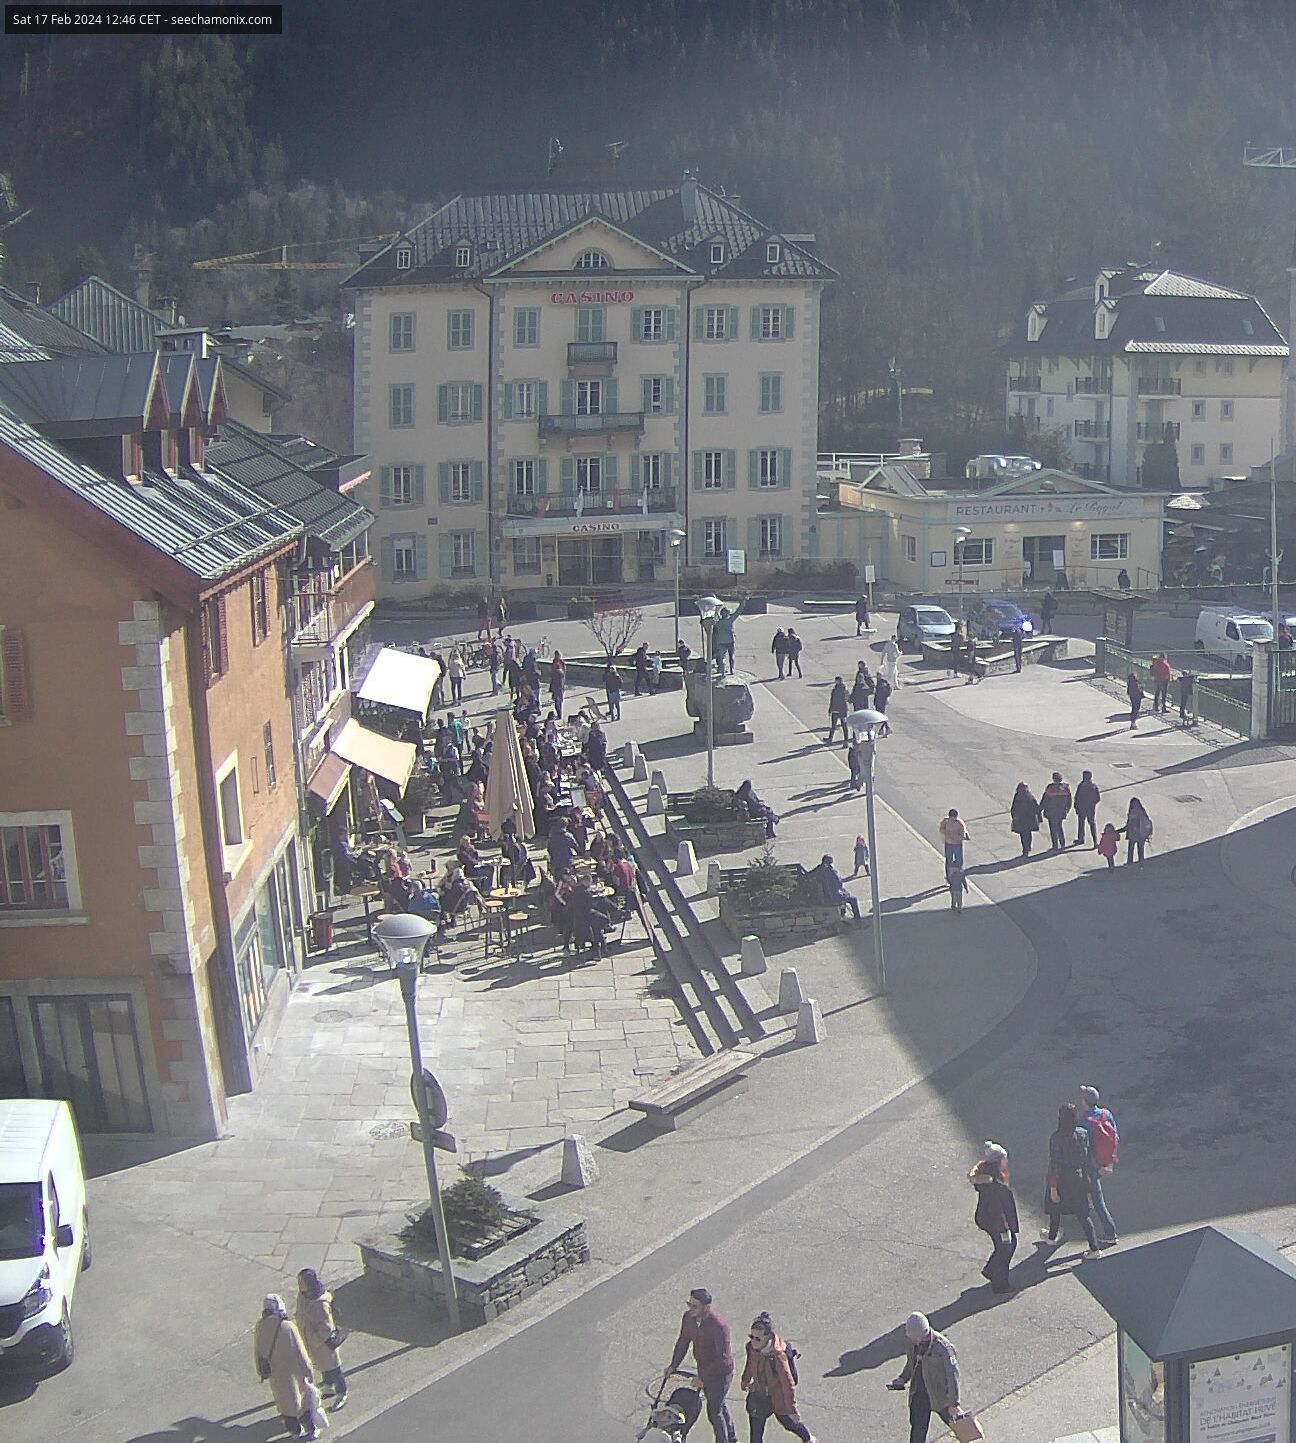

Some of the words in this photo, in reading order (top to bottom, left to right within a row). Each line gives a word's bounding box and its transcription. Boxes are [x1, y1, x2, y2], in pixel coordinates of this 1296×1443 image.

[550, 290, 635, 304] CASINO
[956, 503, 1036, 516] RESTAURANT
[572, 523, 621, 532] CASINO
